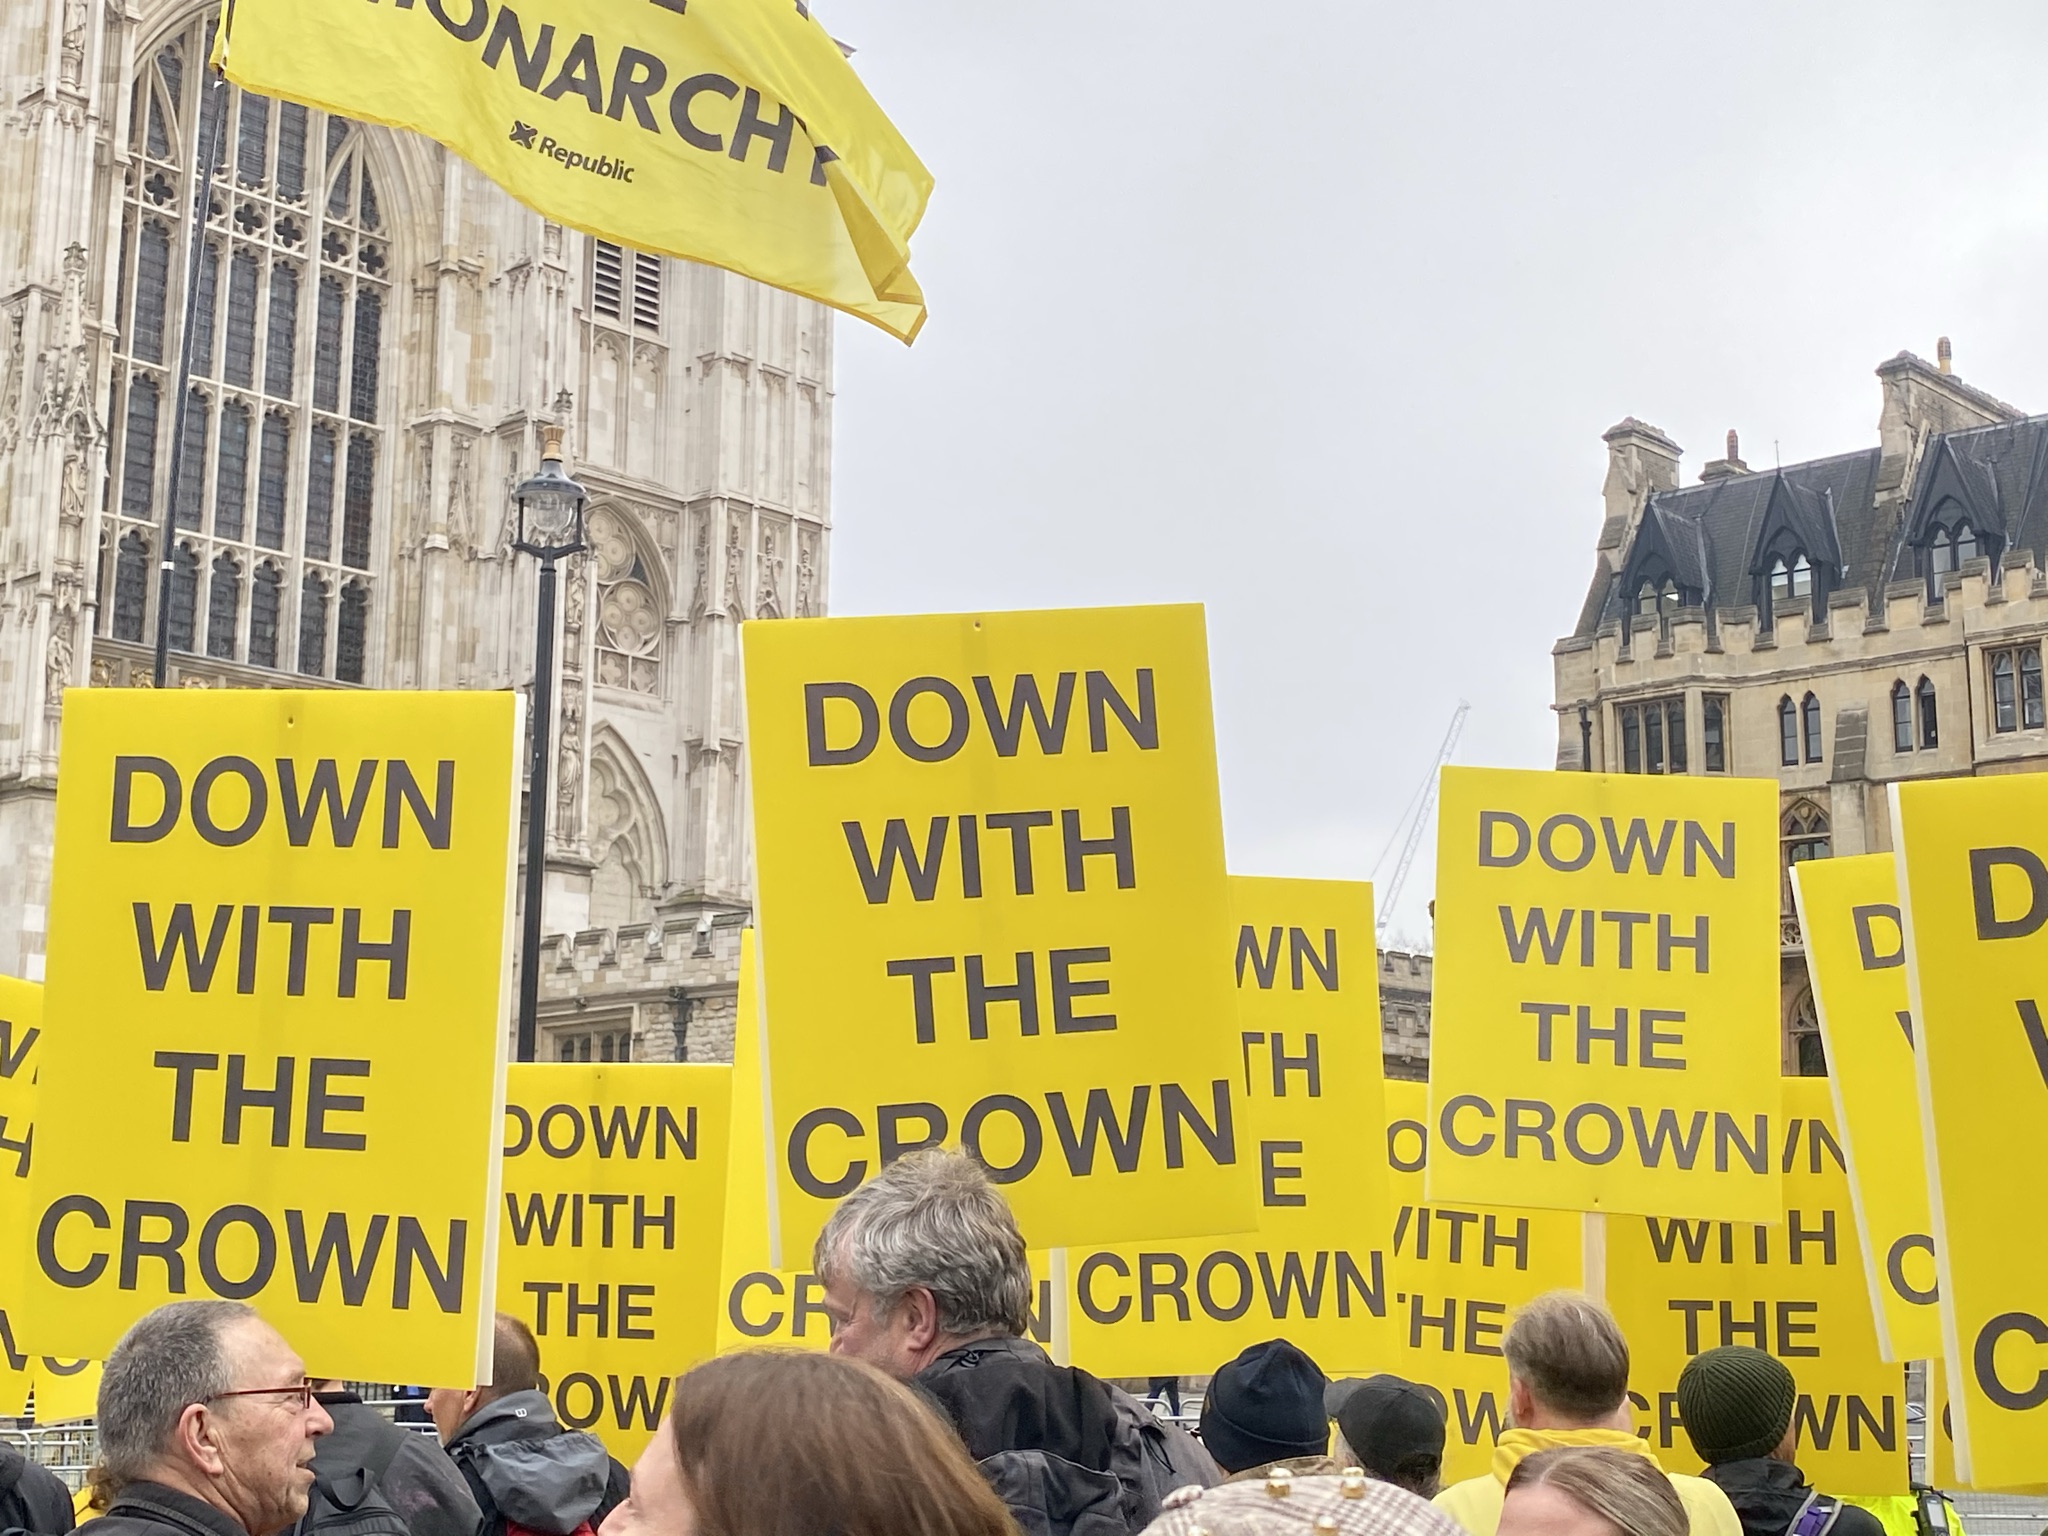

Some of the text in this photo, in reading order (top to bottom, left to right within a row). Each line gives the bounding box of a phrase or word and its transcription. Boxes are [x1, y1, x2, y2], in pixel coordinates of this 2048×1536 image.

[367, 0, 838, 187] ONARCH
[539, 136, 635, 184] Republic
[803, 667, 1160, 767] DOWN
[109, 755, 456, 850] DOWN
[841, 806, 1137, 905] WITH
[1478, 810, 1736, 879] DOWN
[132, 902, 412, 1000] WITH
[1498, 905, 1710, 974] WITH
[886, 946, 1118, 1044] THE
[1521, 1002, 1687, 1070] THE
[153, 1050, 371, 1152] THE
[786, 1079, 1237, 1200] CROWN
[1439, 1095, 1769, 1175] CROWN
[36, 1194, 468, 1315] CROWN
[505, 1192, 676, 1250] WITH
[523, 1281, 655, 1340] THE
[1076, 1250, 1387, 1325] CROWN
[1397, 1293, 1506, 1357] HE
[1668, 1300, 1820, 1358] THE
